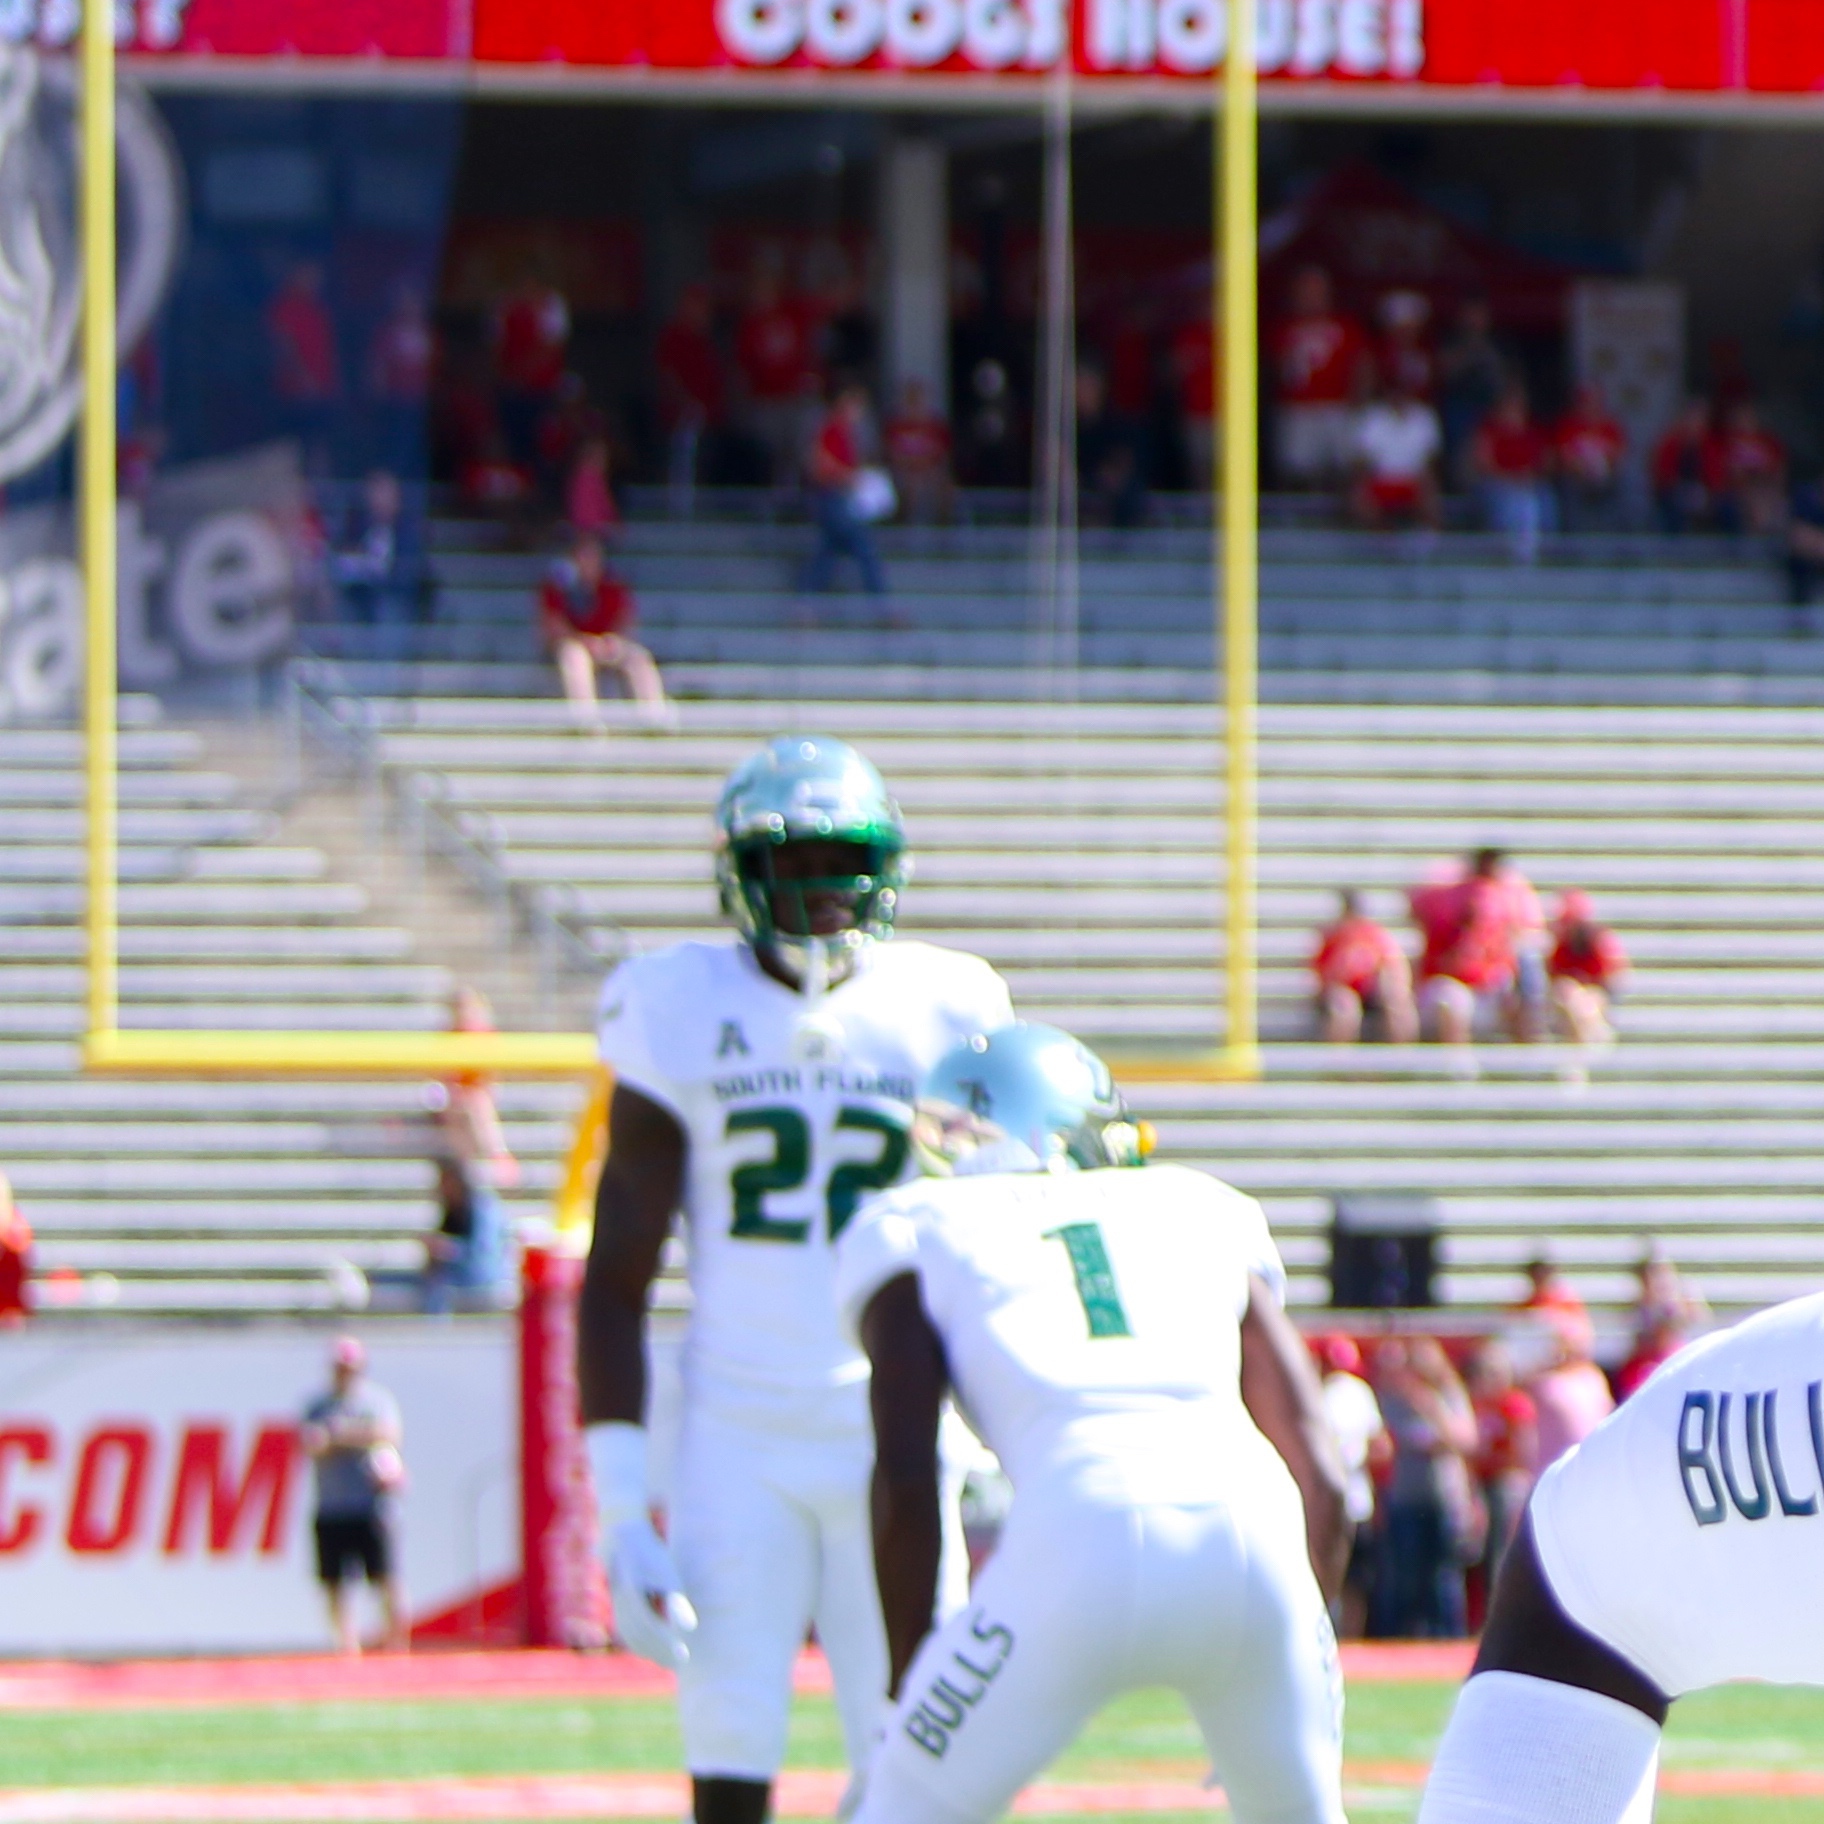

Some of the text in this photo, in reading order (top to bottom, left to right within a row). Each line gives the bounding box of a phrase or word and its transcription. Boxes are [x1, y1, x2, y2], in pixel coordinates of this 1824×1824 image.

[725, 1106, 912, 1245] 22
[1040, 1221, 1136, 1340] 1
[904, 1607, 1016, 1760] BULLS
